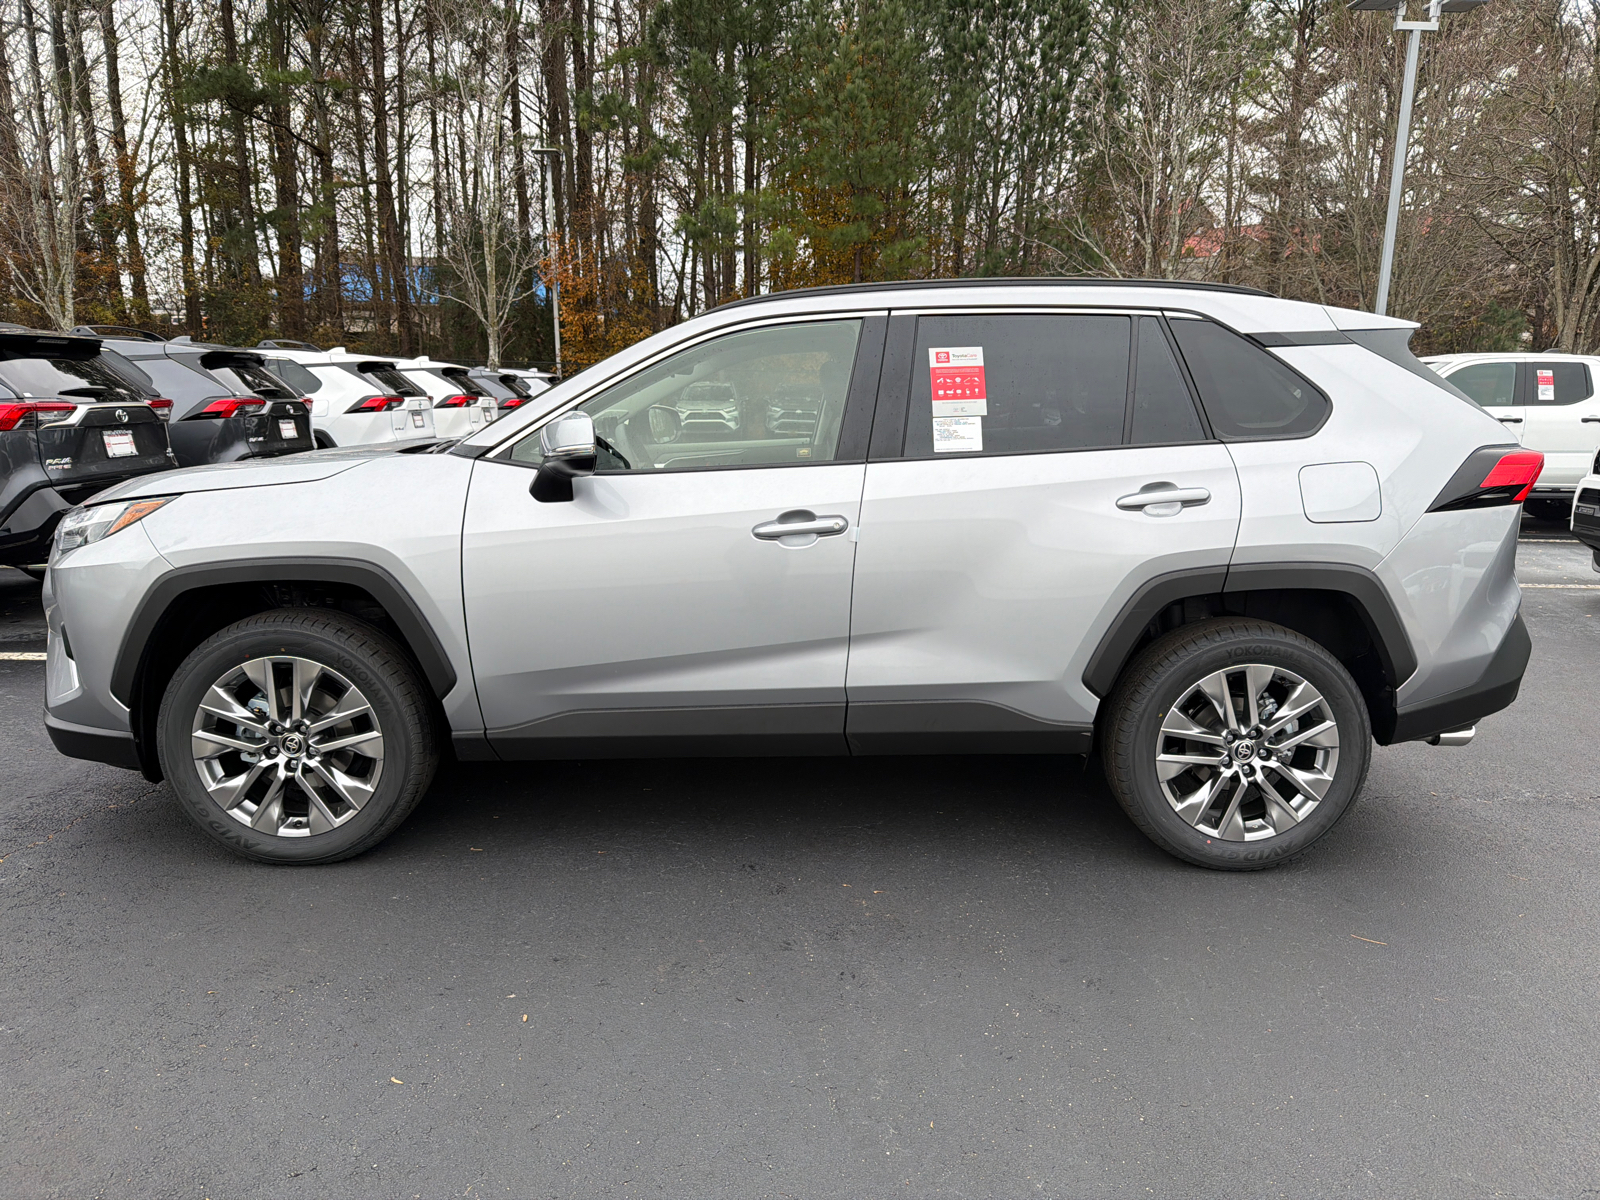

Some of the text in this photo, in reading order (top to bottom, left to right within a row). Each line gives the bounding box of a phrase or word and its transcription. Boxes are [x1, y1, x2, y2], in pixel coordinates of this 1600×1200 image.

[1226, 645, 1303, 663] YOKOHAMA
[336, 653, 394, 716] YOKOHAMA
[208, 820, 262, 849] AVID
[1244, 840, 1294, 861] AVID
